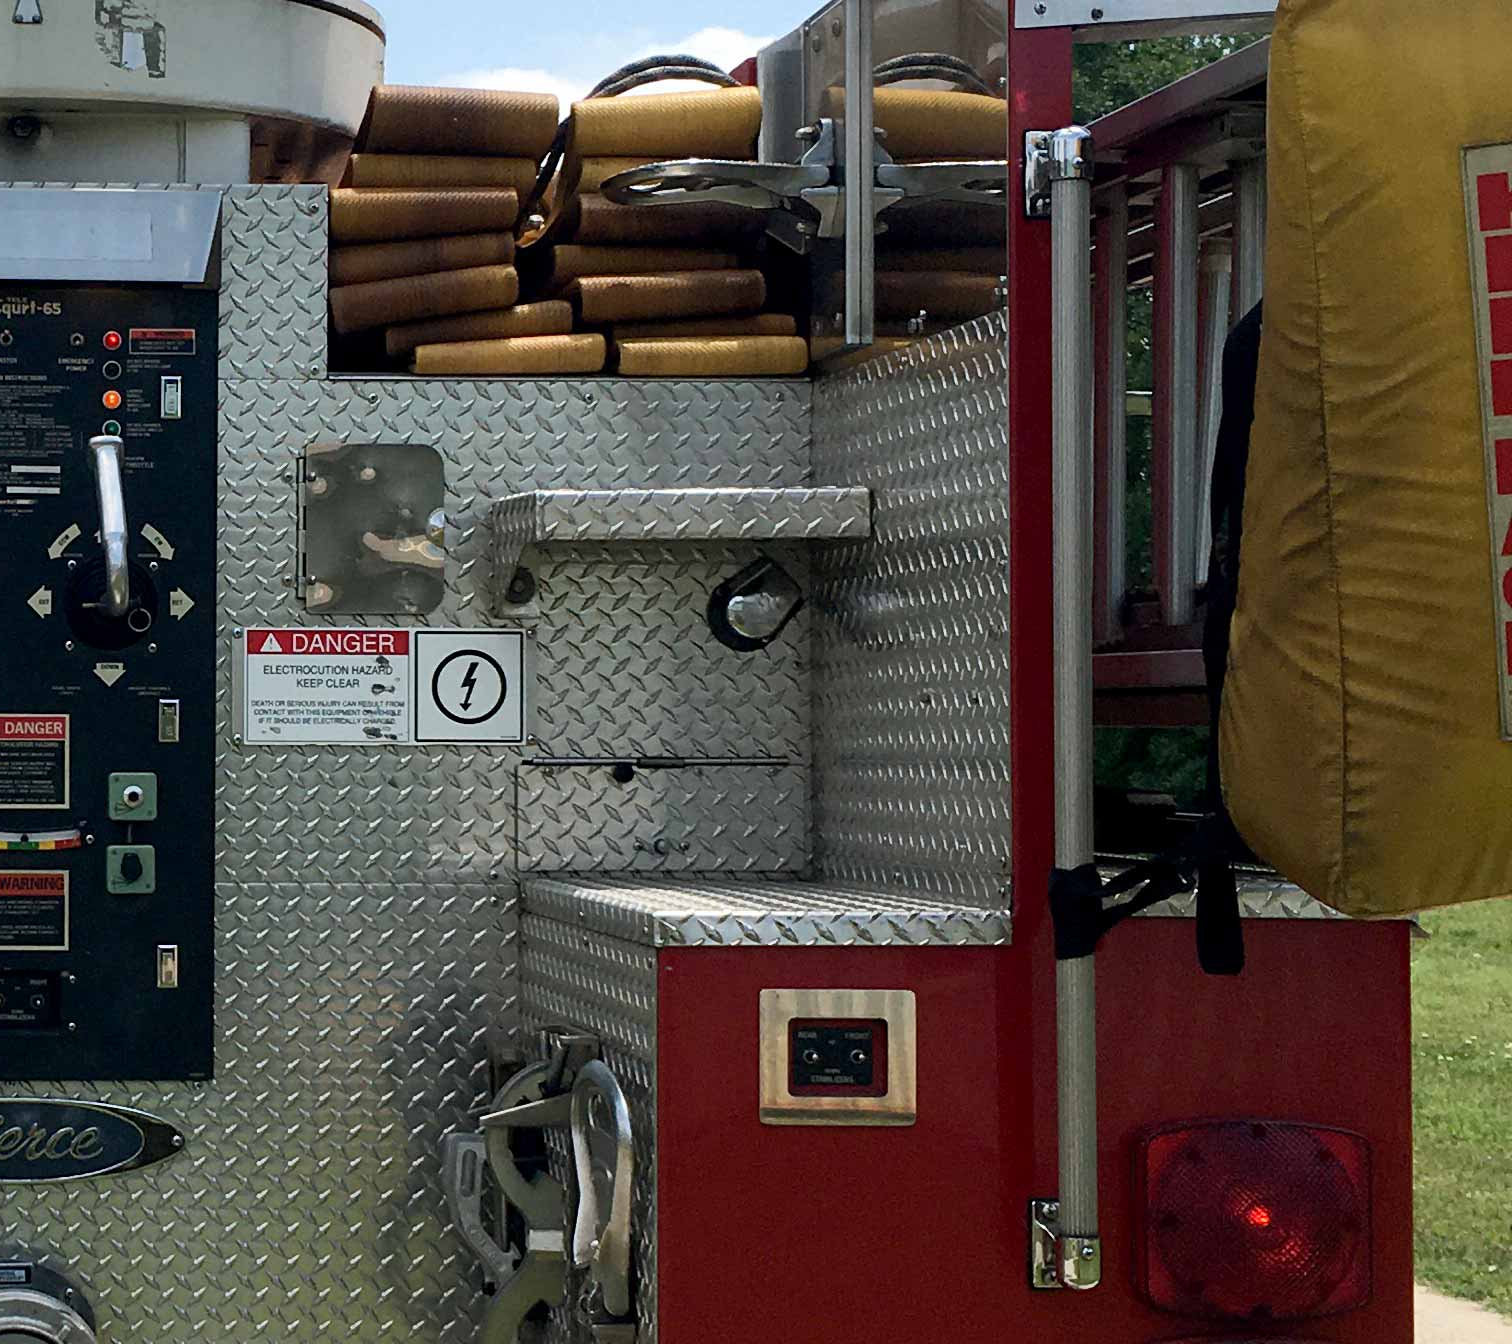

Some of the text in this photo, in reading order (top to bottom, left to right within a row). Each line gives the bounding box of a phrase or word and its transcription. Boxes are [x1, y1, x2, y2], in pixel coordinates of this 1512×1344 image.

[292, 633, 395, 654] DANGER
[263, 665, 393, 676] ELECTROCUTION HAZARD
[296, 678, 360, 688] KEEP CLEAR
[4, 721, 62, 734] DANGER
[0, 877, 64, 890] WARNING
[810, 1075, 854, 1083] STABILIZERS
